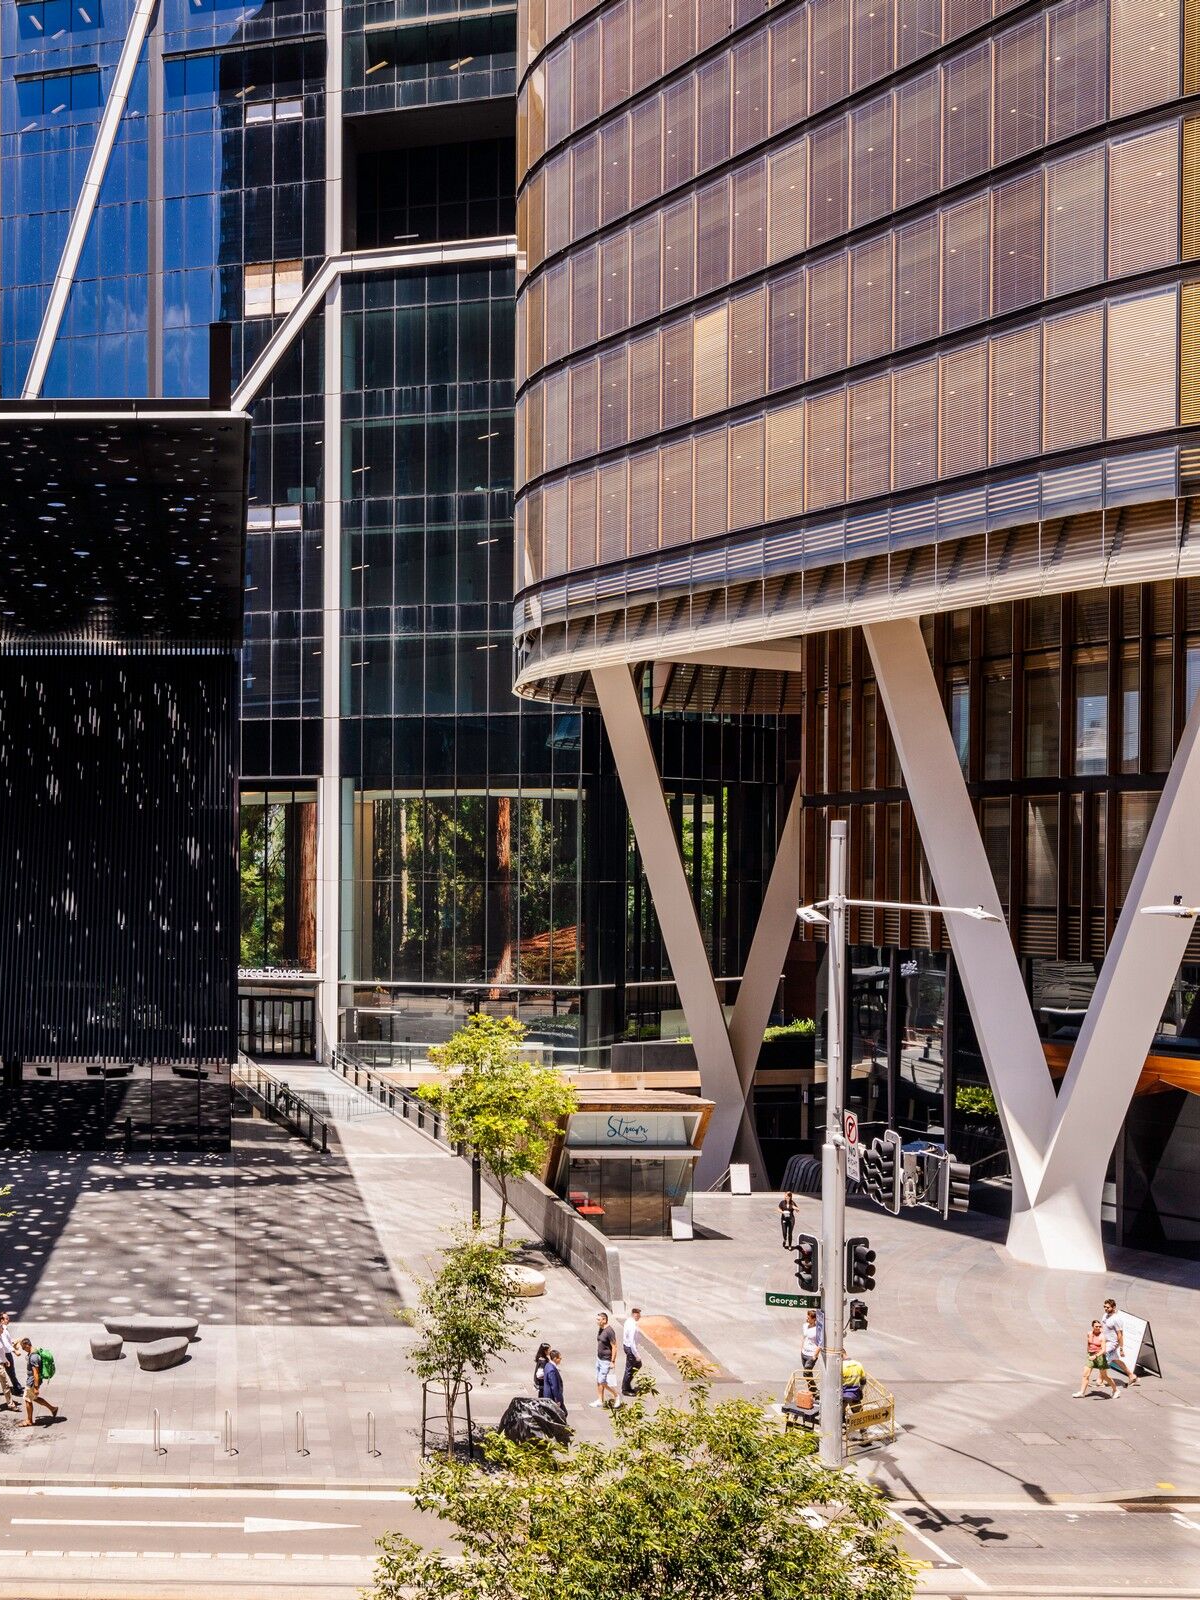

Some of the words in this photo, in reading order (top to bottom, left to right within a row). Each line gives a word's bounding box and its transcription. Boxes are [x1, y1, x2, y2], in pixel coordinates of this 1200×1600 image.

[265, 966, 303, 978] Tower
[848, 1145, 857, 1158] NO
[848, 1166, 858, 1178] TURN
[768, 1296, 798, 1307] George
[799, 1298, 808, 1306] St
[850, 1412, 882, 1427] PEDESTRIANS
